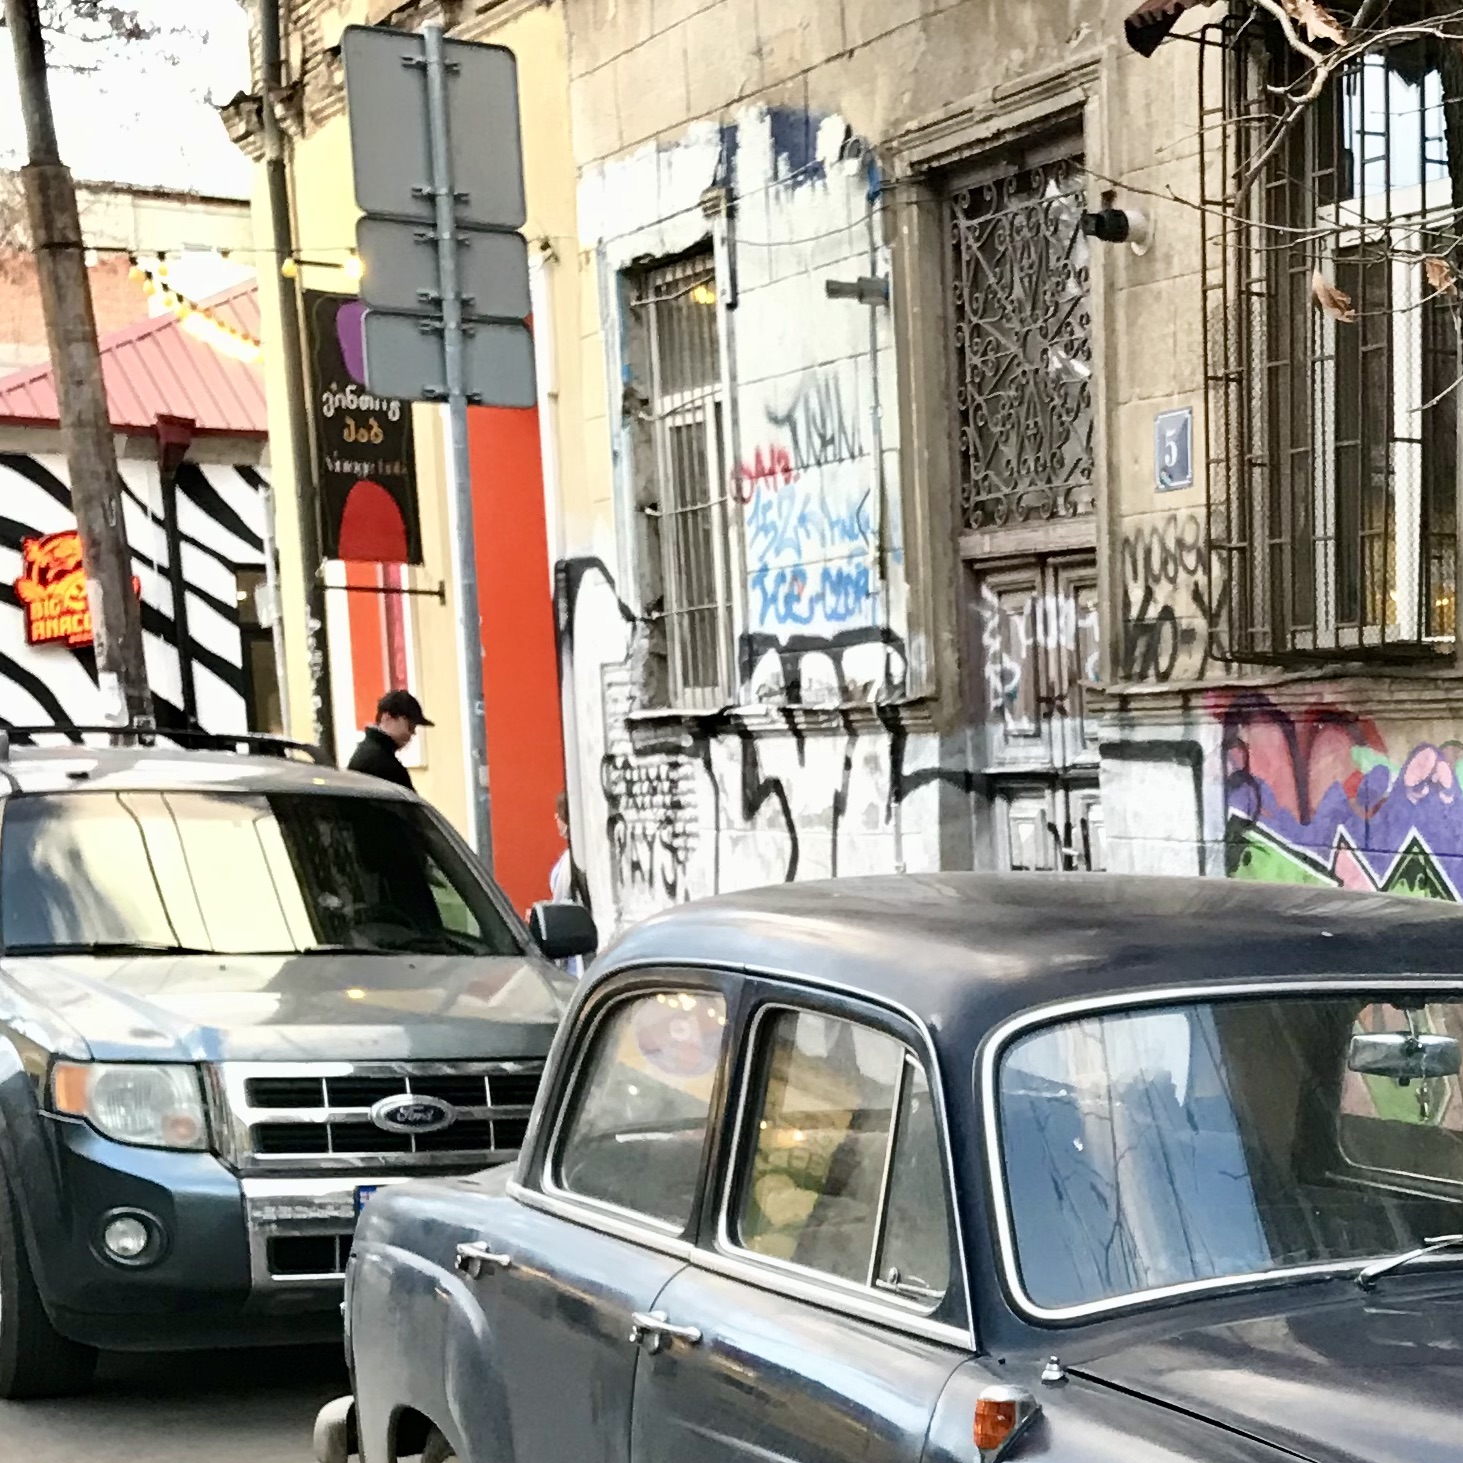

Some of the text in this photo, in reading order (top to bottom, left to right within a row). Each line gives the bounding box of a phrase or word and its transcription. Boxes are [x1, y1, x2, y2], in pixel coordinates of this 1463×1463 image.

[1163, 429, 1179, 467] 5
[30, 599, 61, 620] BIG
[396, 1104, 434, 1122] Ford
